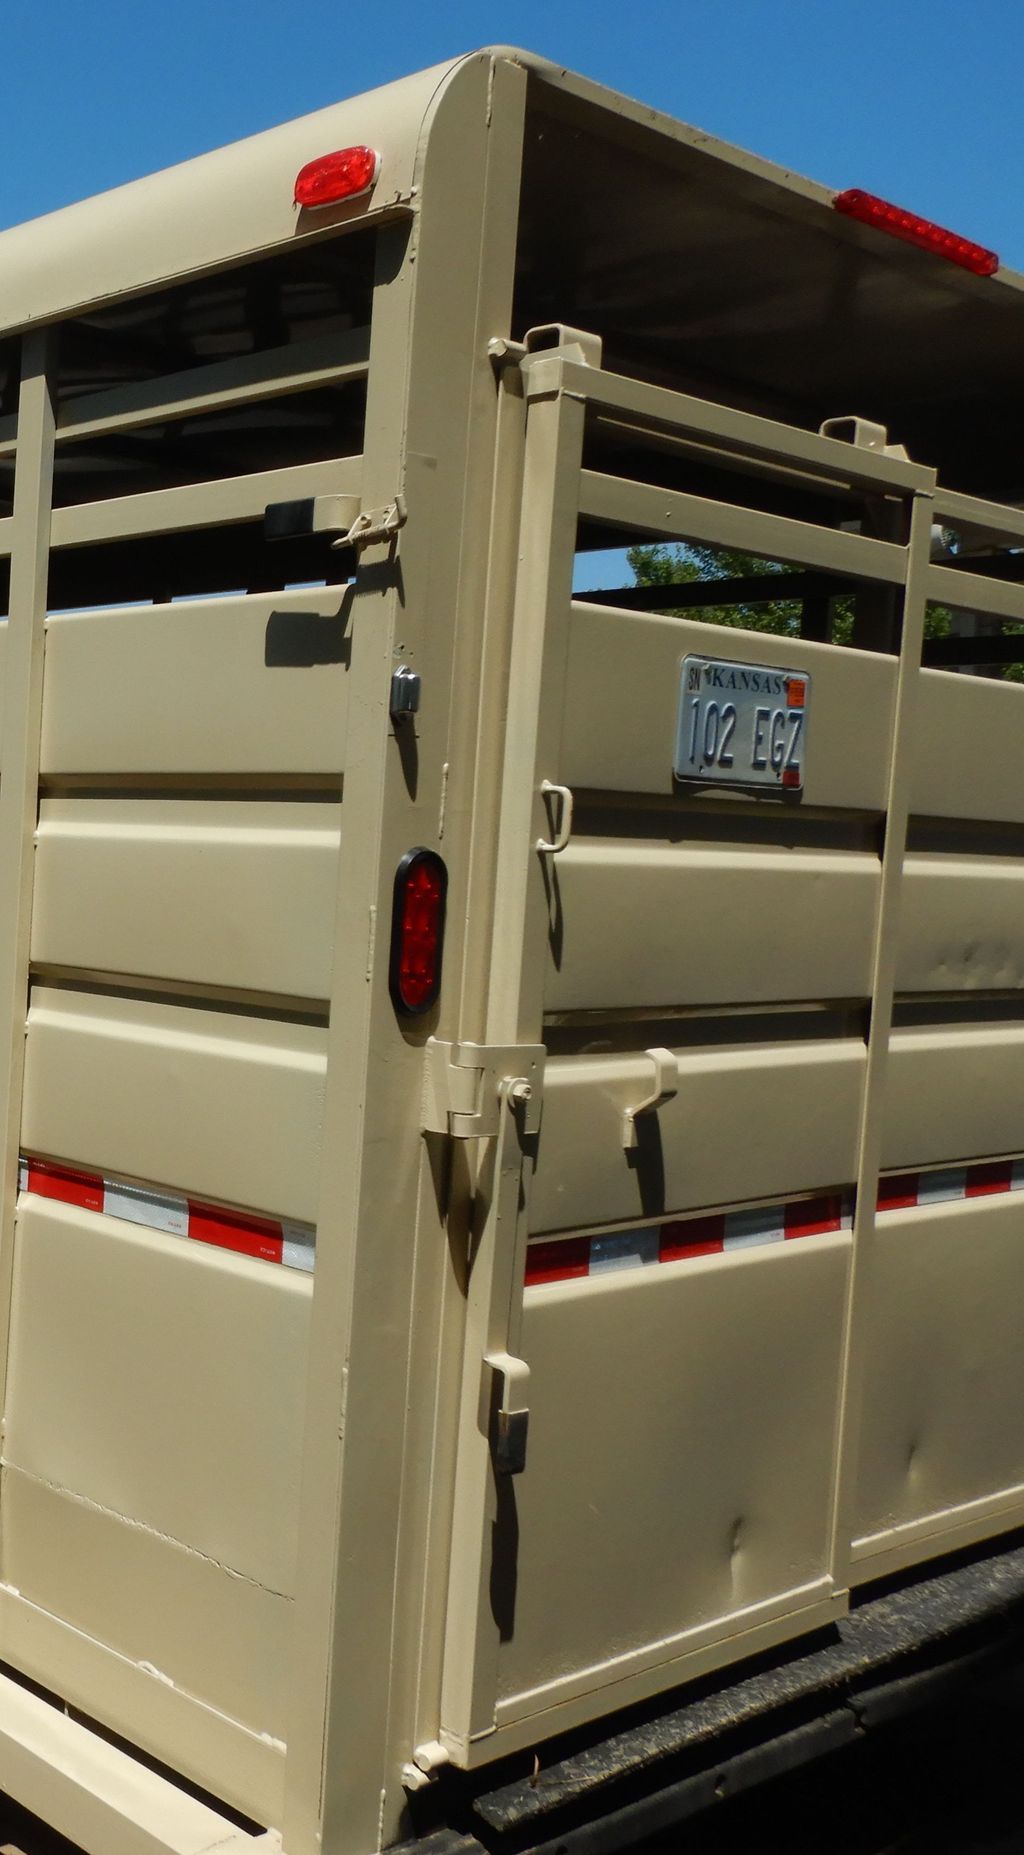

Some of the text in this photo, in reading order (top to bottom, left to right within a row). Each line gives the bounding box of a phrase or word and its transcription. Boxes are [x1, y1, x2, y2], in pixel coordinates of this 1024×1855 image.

[711, 668, 782, 695] KANSAS
[689, 698, 804, 773] 102 EGZ
